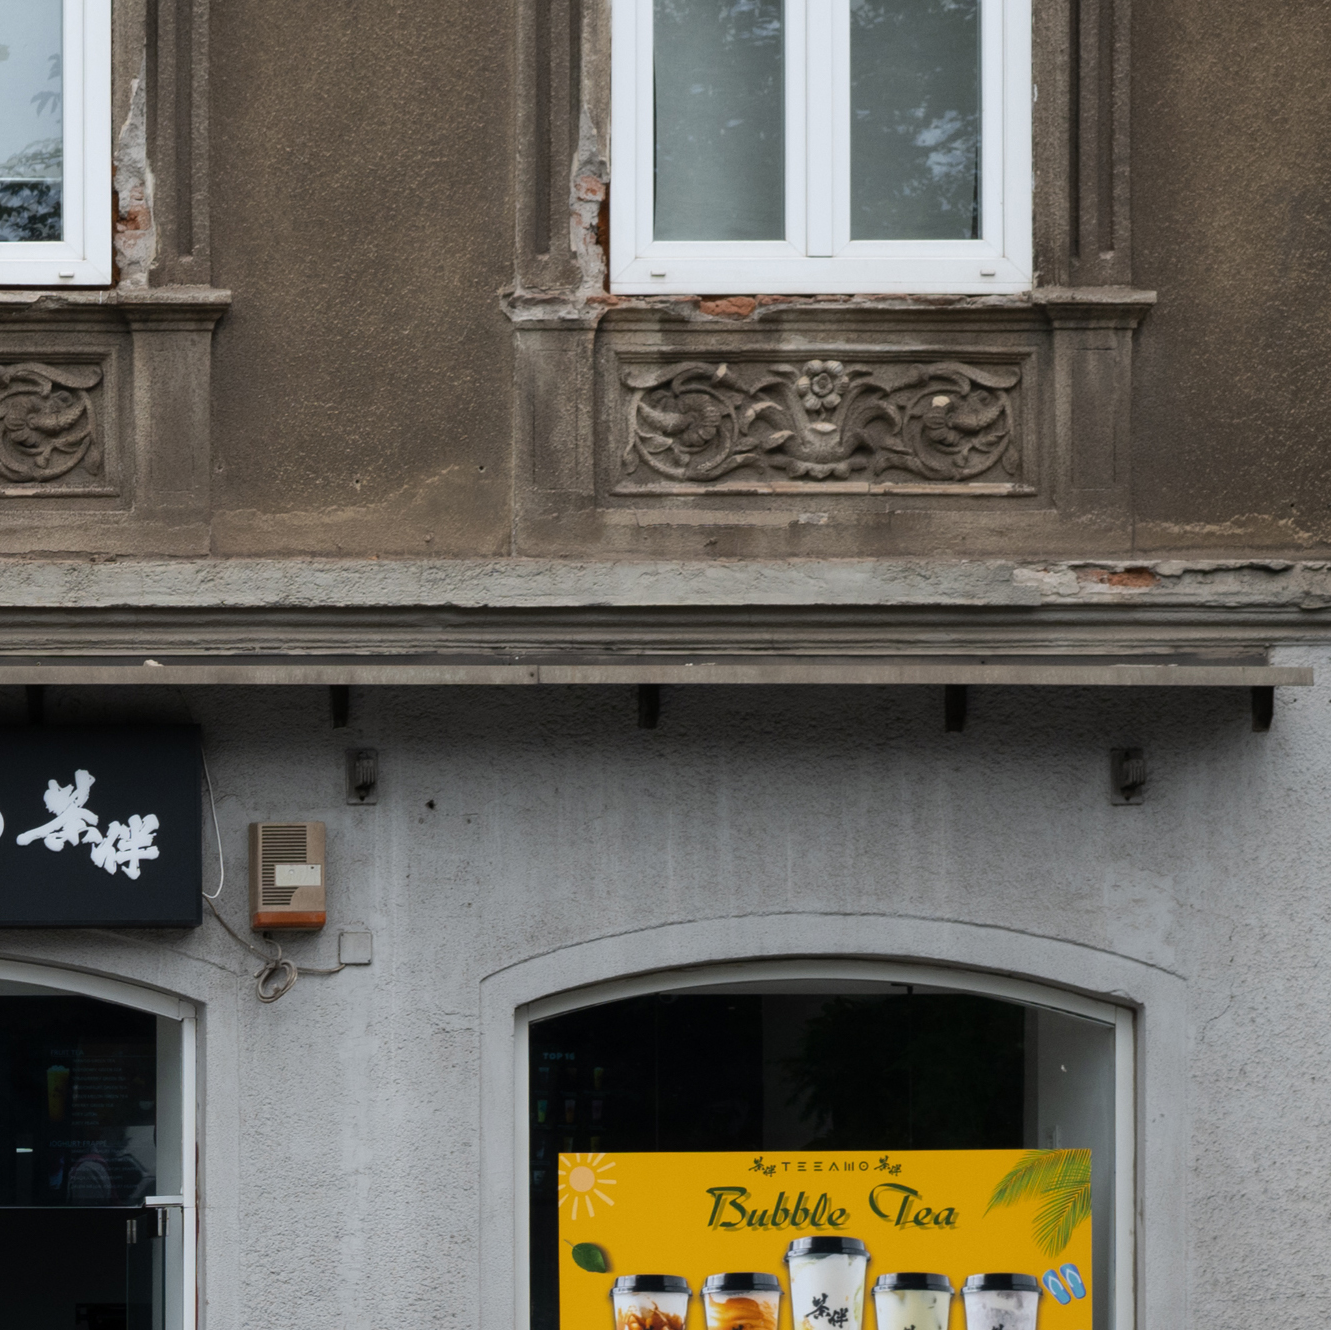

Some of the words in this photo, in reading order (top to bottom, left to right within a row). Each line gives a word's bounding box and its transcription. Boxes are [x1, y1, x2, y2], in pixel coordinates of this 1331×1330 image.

[782, 1160, 869, 1172] TEEAMO
[705, 1185, 847, 1229] Bubble
[869, 1183, 957, 1226] Tea
